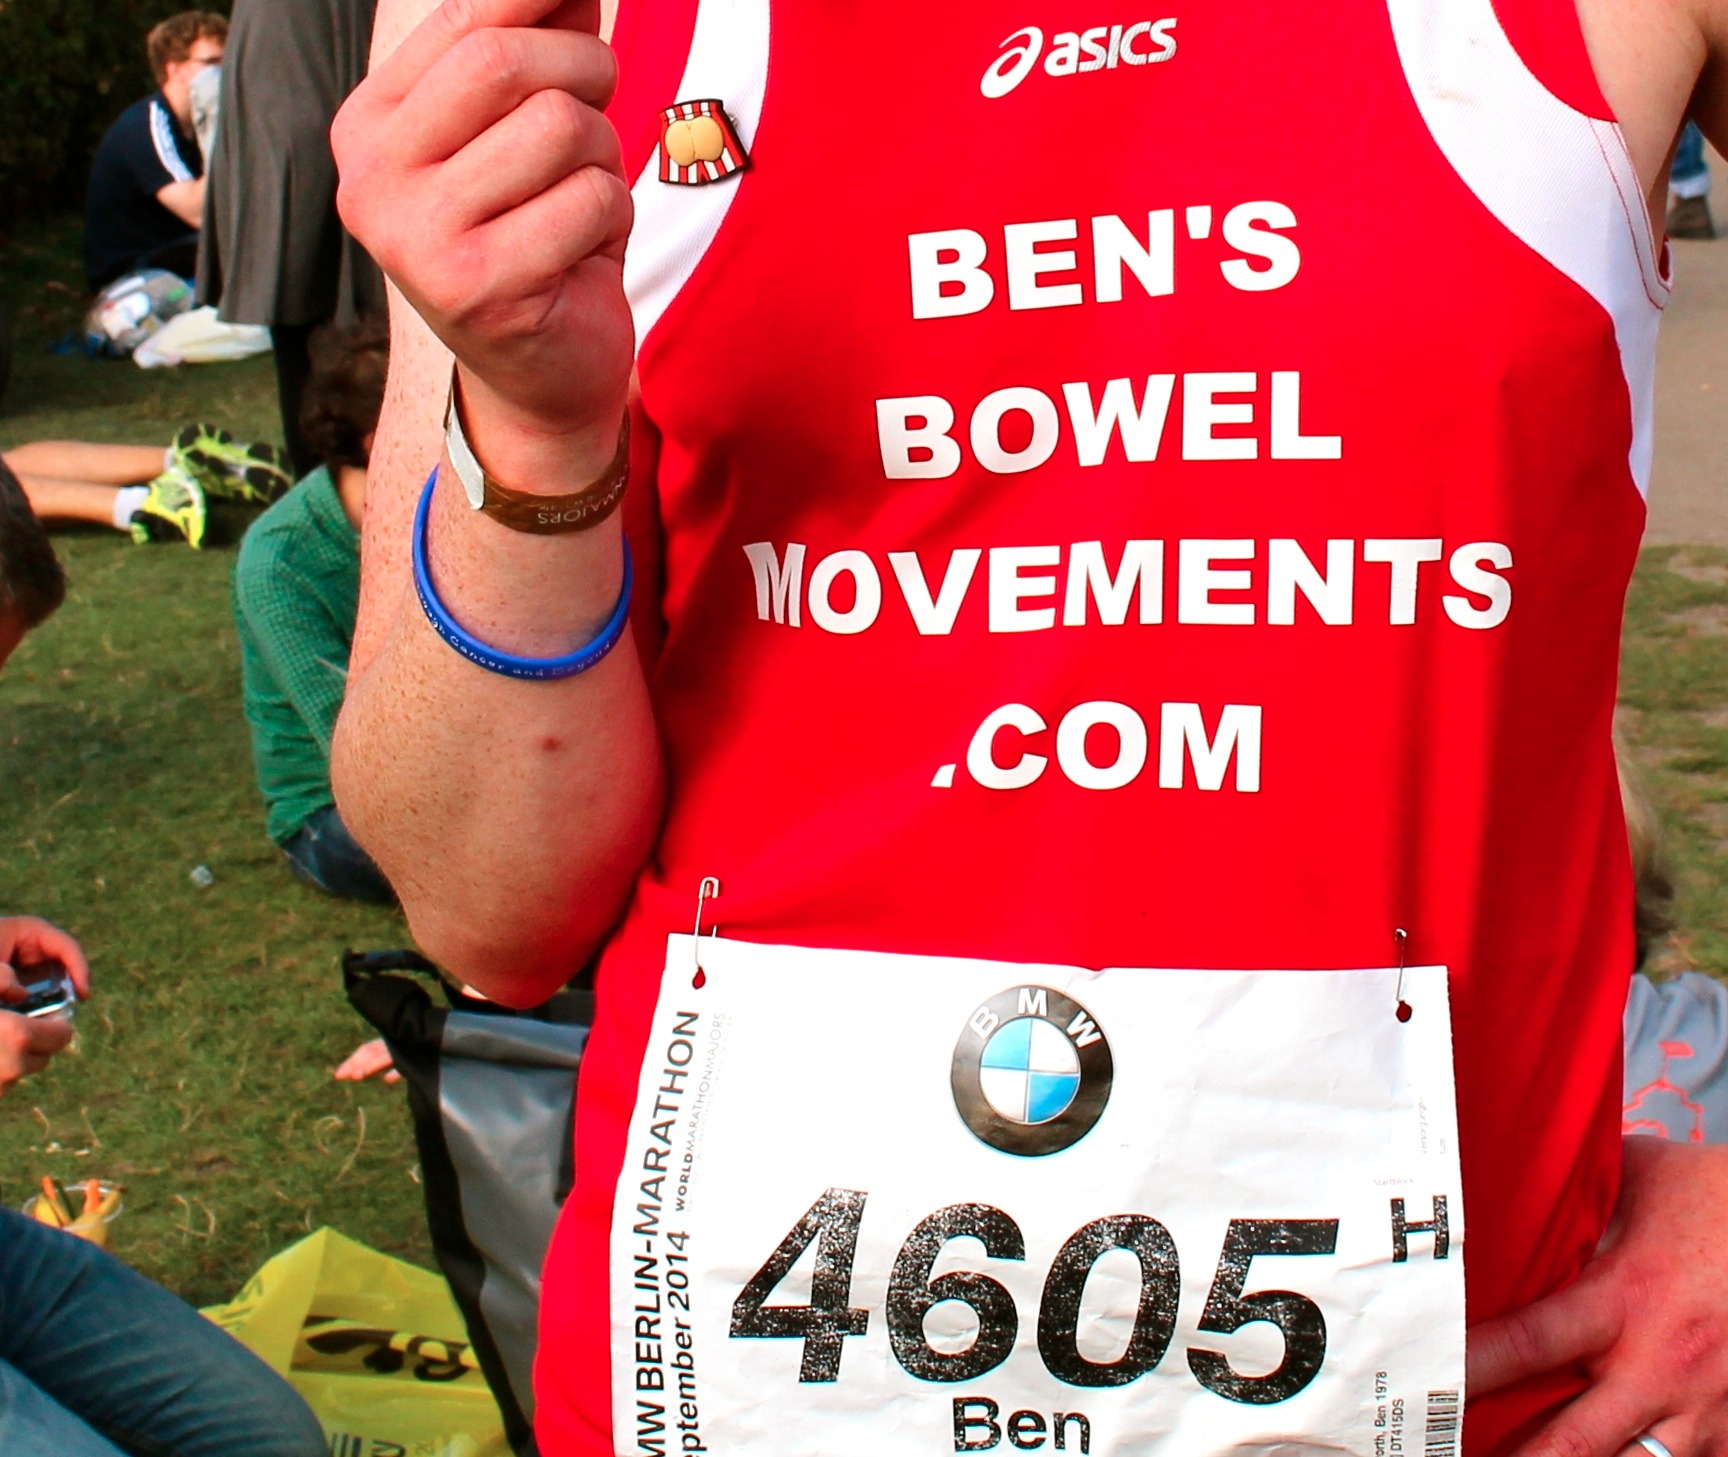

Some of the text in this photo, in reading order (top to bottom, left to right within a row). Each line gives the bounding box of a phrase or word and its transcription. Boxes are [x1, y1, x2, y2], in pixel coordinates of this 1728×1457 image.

[907, 200, 1303, 320] BEN'S
[875, 370, 1343, 481] BOWEL
[742, 537, 1514, 636] MOVEMENTS
[930, 701, 1264, 794] .COM
[968, 987, 1103, 1053] BMW
[633, 1010, 700, 1457] MW BERLIN-MARATHON
[1390, 1194, 1450, 1263] H
[665, 1230, 707, 1457] ptember 2014
[728, 1187, 1341, 1406] 4605
[950, 1396, 1092, 1455] Ben
[1374, 1405, 1387, 1428] Ben
[1375, 1370, 1388, 1401] 1978
